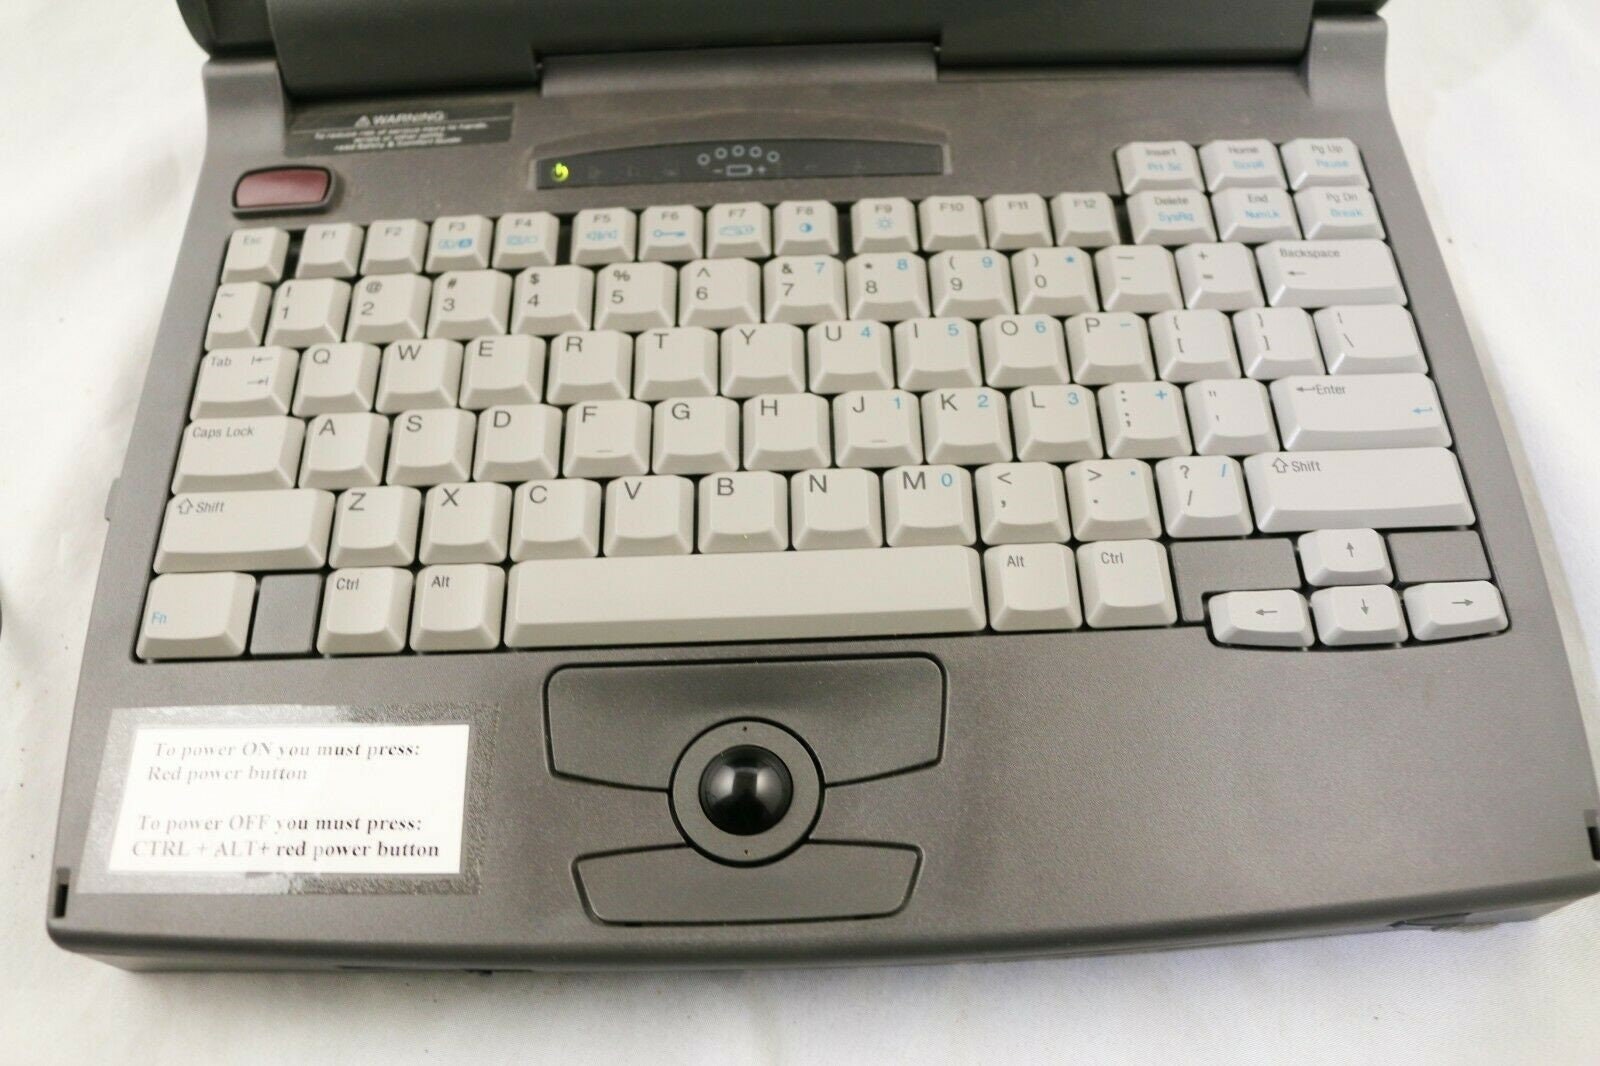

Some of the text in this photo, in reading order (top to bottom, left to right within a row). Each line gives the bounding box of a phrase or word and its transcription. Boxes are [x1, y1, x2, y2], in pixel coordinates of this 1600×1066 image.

[1145, 148, 1176, 156] Insert
[1311, 144, 1325, 155] Pg
[1073, 198, 1096, 209] F12
[1154, 197, 1188, 205] Delete
[1248, 194, 1268, 203] End
[1326, 192, 1341, 203] Pg
[796, 206, 813, 216] F8
[875, 204, 892, 213] F9
[940, 202, 964, 212] F10
[1008, 201, 1028, 209] F11
[593, 214, 611, 223] F5
[661, 211, 679, 220] F6
[728, 208, 746, 218] F7
[448, 222, 466, 232] F3
[515, 219, 532, 227] F4
[321, 230, 336, 239] F1
[384, 226, 402, 236] F2
[243, 235, 261, 246] Esc
[1279, 248, 1340, 259] Backspace
[896, 258, 908, 271] 8
[949, 256, 955, 270] (
[982, 256, 993, 268] 9
[1032, 254, 1039, 267] )
[782, 263, 793, 274] &
[815, 261, 825, 274] 7
[530, 273, 539, 285] $
[613, 270, 630, 281] %
[1034, 275, 1047, 288] 0
[366, 281, 382, 294] @
[448, 278, 457, 288] #
[782, 283, 794, 296] 7
[865, 280, 878, 294] 8
[950, 277, 963, 291] 9
[612, 290, 624, 304] 5
[696, 287, 708, 300] 6
[443, 298, 455, 312] 3
[527, 294, 539, 307] 4
[361, 301, 374, 316] 2
[948, 323, 959, 336] 5
[1001, 320, 1019, 336] O
[1035, 321, 1046, 334] 6
[1085, 317, 1100, 333] P
[740, 329, 756, 345] Y
[825, 326, 842, 341] U
[861, 326, 871, 338] 4
[566, 336, 583, 352] R
[653, 333, 669, 349] T
[398, 345, 421, 360] W
[478, 340, 493, 357] E
[211, 356, 232, 367] Tab
[312, 348, 330, 364] Q
[1316, 383, 1346, 396] Enter
[852, 396, 865, 413] J
[894, 397, 900, 409] 1
[941, 394, 957, 411] K
[977, 394, 989, 408] 2
[1031, 391, 1045, 408] L
[1068, 392, 1079, 405] 3
[672, 403, 690, 420] G
[761, 399, 777, 416] H
[493, 411, 511, 428] D
[582, 406, 597, 423] F
[319, 419, 335, 435] A
[406, 415, 422, 432] S
[193, 426, 253, 439] Caps Lock
[1180, 465, 1190, 479] ?
[1291, 461, 1320, 472] Shift
[903, 471, 926, 490] M
[997, 472, 1012, 484] <
[1087, 469, 1102, 481] >
[717, 478, 734, 496] B
[809, 474, 827, 493] N
[442, 488, 459, 506] X
[529, 485, 547, 504] C
[625, 482, 642, 500] V
[196, 502, 224, 513] Shift
[348, 492, 366, 511] Z
[1007, 555, 1024, 567] Alt
[1101, 552, 1123, 564] Ctrl
[336, 578, 359, 590] Ctrl
[432, 576, 450, 587] Alt
[151, 612, 167, 624] Fn
[154, 742, 420, 761] To power ON you must press:
[147, 765, 308, 786] Red power button
[138, 814, 422, 835] To power OFF you must press:
[131, 840, 190, 858] CTRL
[276, 840, 307, 857] red
[312, 845, 372, 862] power
[376, 840, 440, 857] button
